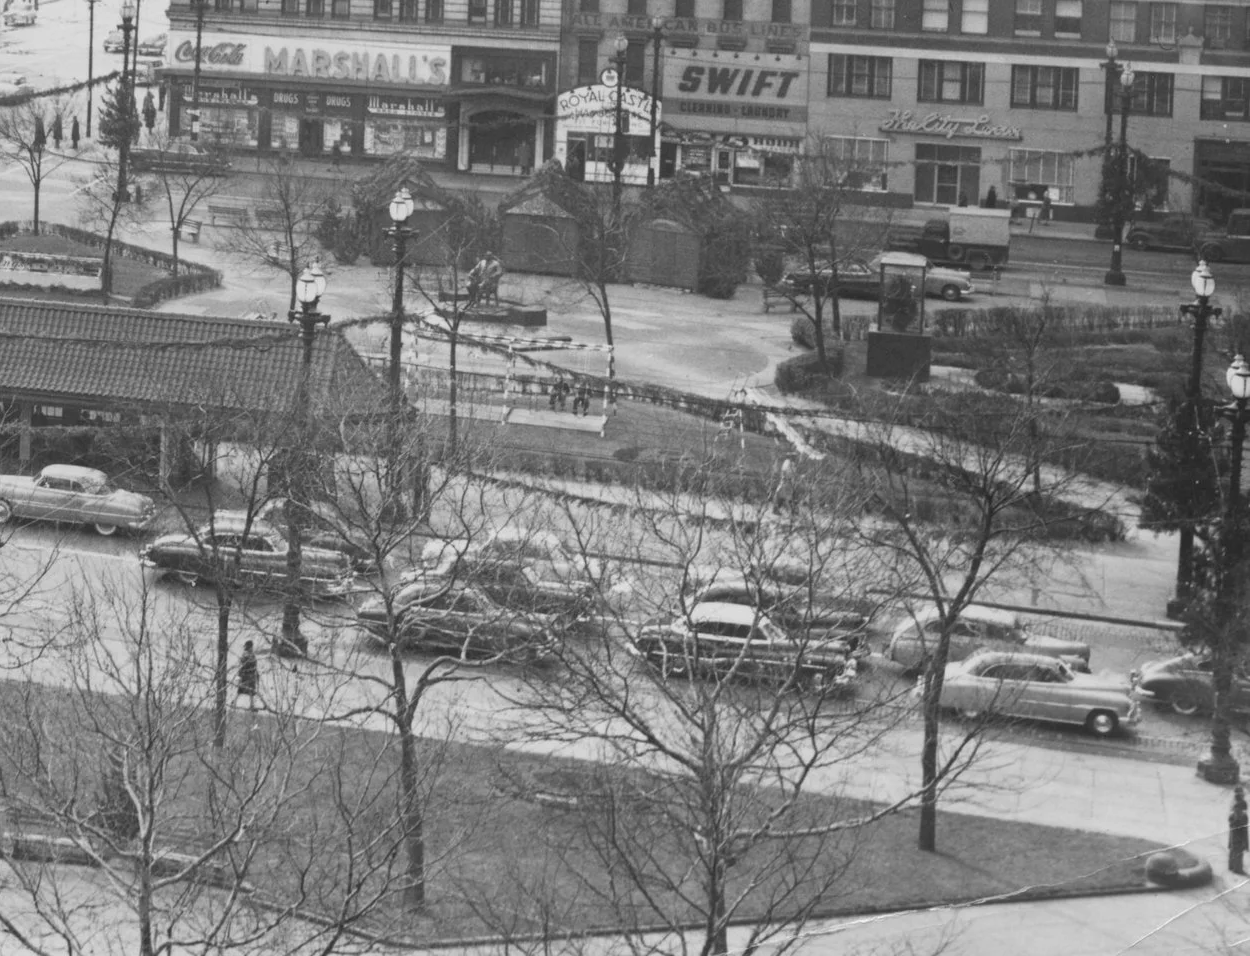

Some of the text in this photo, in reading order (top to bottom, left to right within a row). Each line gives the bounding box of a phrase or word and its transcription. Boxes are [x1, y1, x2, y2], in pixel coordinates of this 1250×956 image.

[707, 20, 742, 34] BUS
[751, 23, 802, 37] LINES
[263, 46, 447, 85] MARSHALL'S
[678, 66, 800, 99] SWIFT
[273, 91, 299, 104] DRUGS
[326, 96, 352, 108] DRUGS
[559, 91, 605, 112] ROYAL
[680, 102, 790, 120] CLEANING LAUNDRY
[882, 108, 1022, 139] The City Loan
